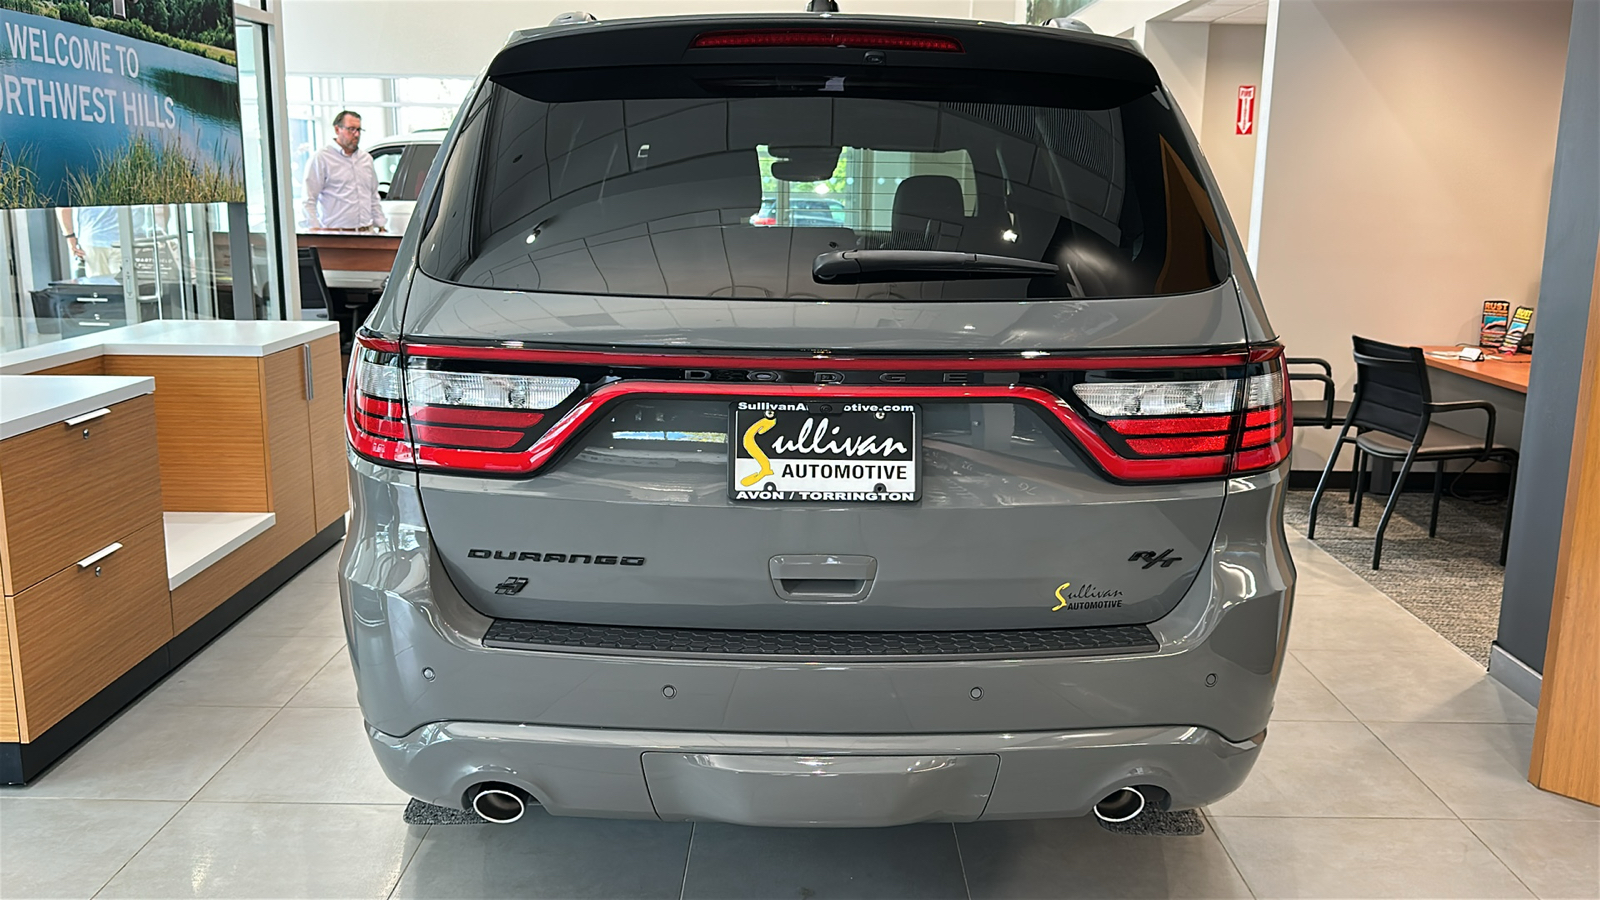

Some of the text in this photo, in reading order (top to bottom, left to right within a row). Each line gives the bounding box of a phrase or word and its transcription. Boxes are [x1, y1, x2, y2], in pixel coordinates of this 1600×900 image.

[5, 22, 139, 78] WELCOME TO
[123, 91, 176, 130] HILLS
[1484, 302, 1509, 311] RUST
[684, 368, 968, 385] DODGE
[738, 402, 914, 412] SullivanAotive.com
[740, 417, 907, 487] Sullivan
[782, 463, 907, 480] AUTOMOTIVE
[736, 491, 784, 500] AVON
[800, 491, 914, 501] TORRINGTON
[467, 548, 646, 567] DURANGO
[1128, 548, 1182, 569] R/T
[1052, 582, 1123, 611] Sullivan
[1067, 600, 1122, 610] AUTOMOTIVE
